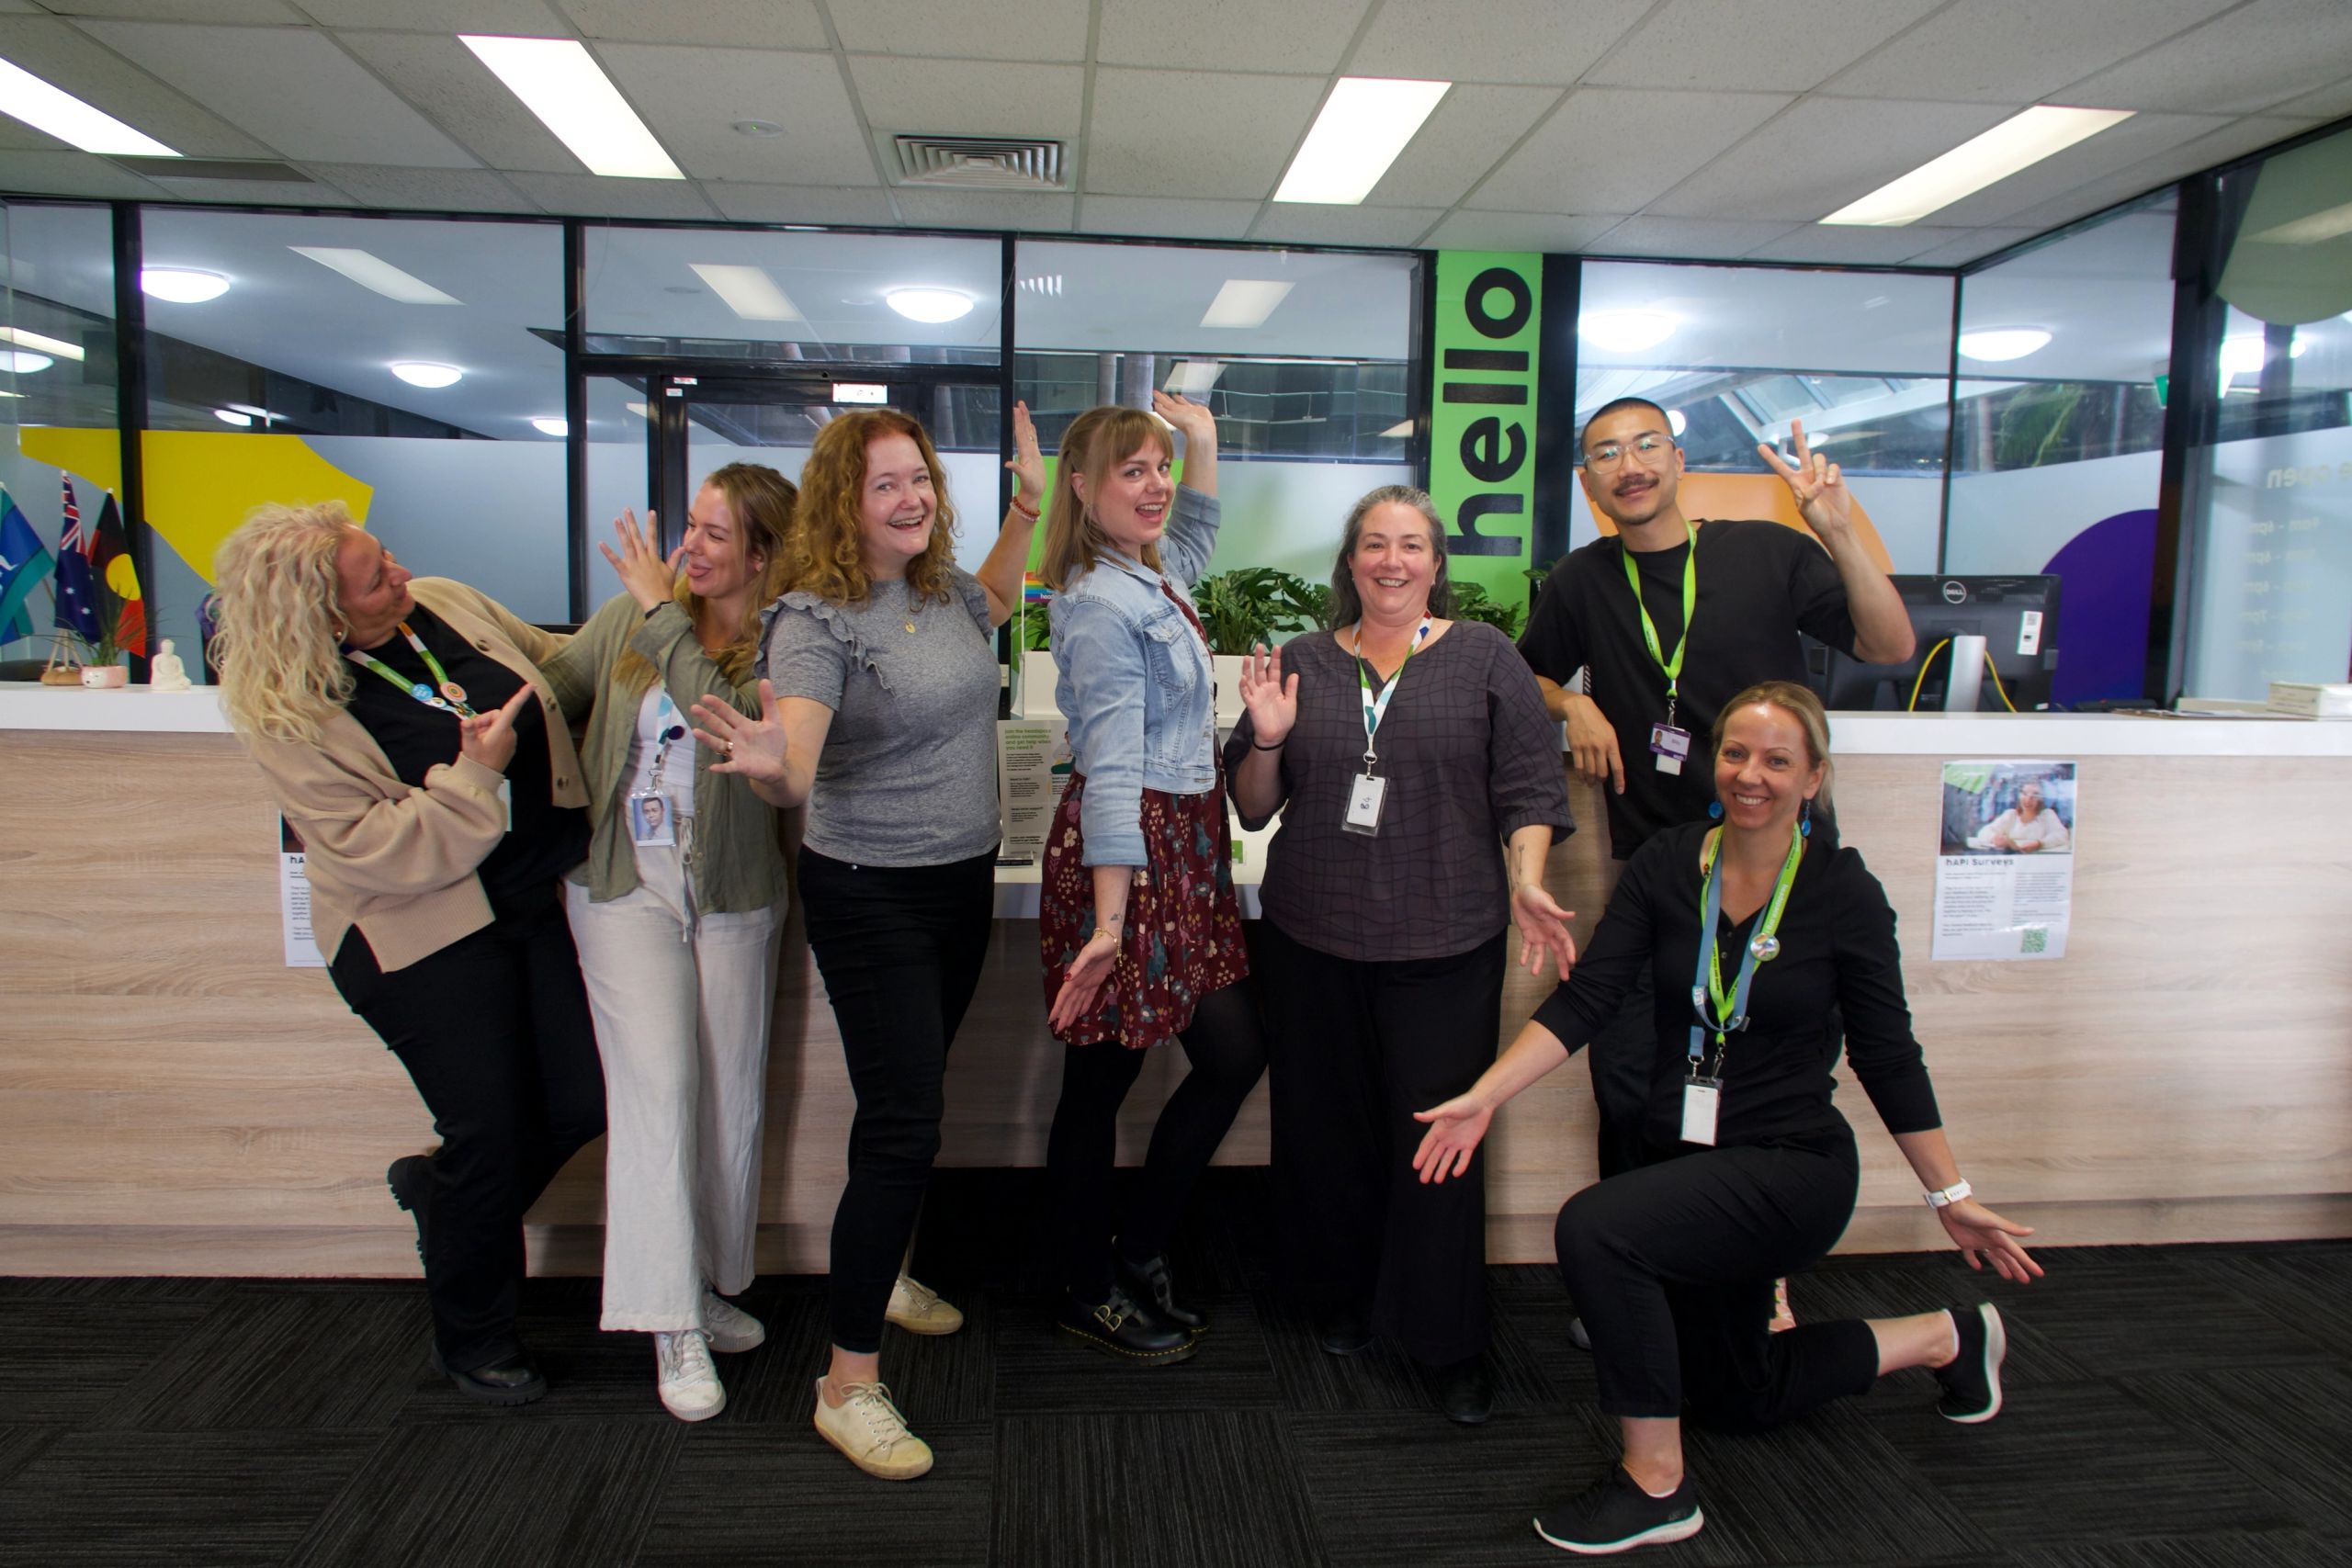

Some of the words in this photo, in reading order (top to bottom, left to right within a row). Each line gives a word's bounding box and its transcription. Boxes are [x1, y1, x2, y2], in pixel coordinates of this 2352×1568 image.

[1442, 267, 1532, 557] hello
[290, 856, 305, 864] hA
[1972, 858, 2015, 867] Surveys
